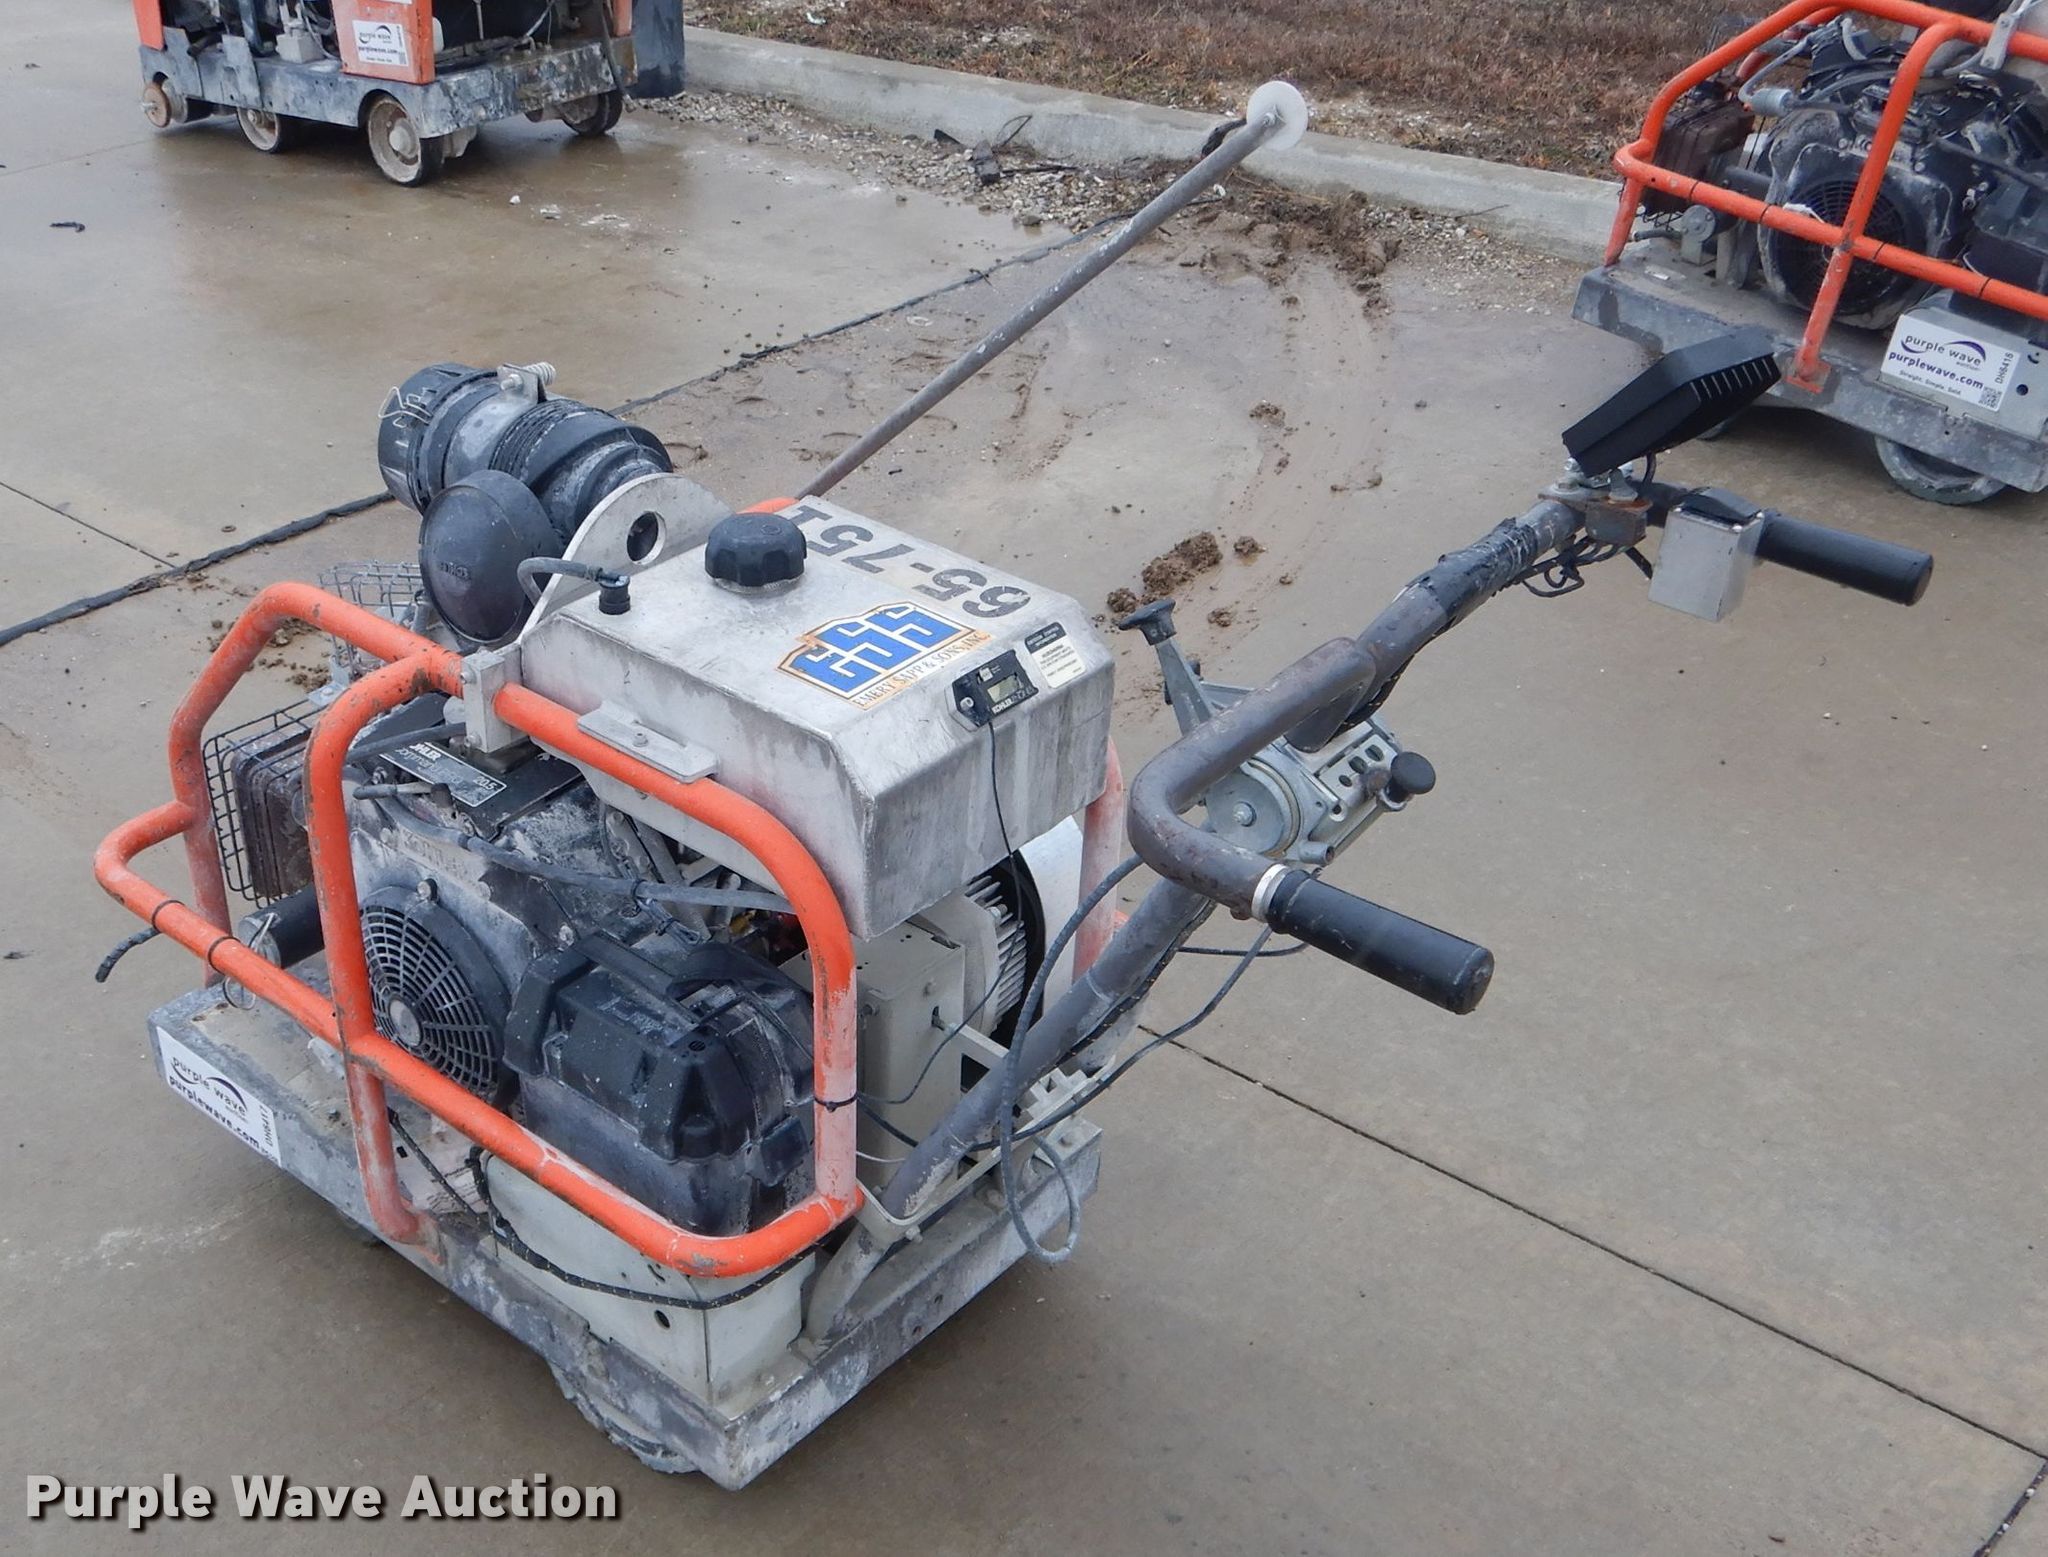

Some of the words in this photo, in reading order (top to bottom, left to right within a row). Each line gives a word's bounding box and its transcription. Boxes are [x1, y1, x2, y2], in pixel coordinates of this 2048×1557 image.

[1888, 351, 1984, 389] purplewave.com
[1905, 335, 1945, 354] purple
[1949, 348, 1981, 366] wave
[851, 680, 897, 707] EMERY
[897, 664, 925, 687] SAPP
[173, 1057, 210, 1090] purple
[214, 1087, 246, 1117] wave
[169, 1075, 260, 1148] purplewave.com
